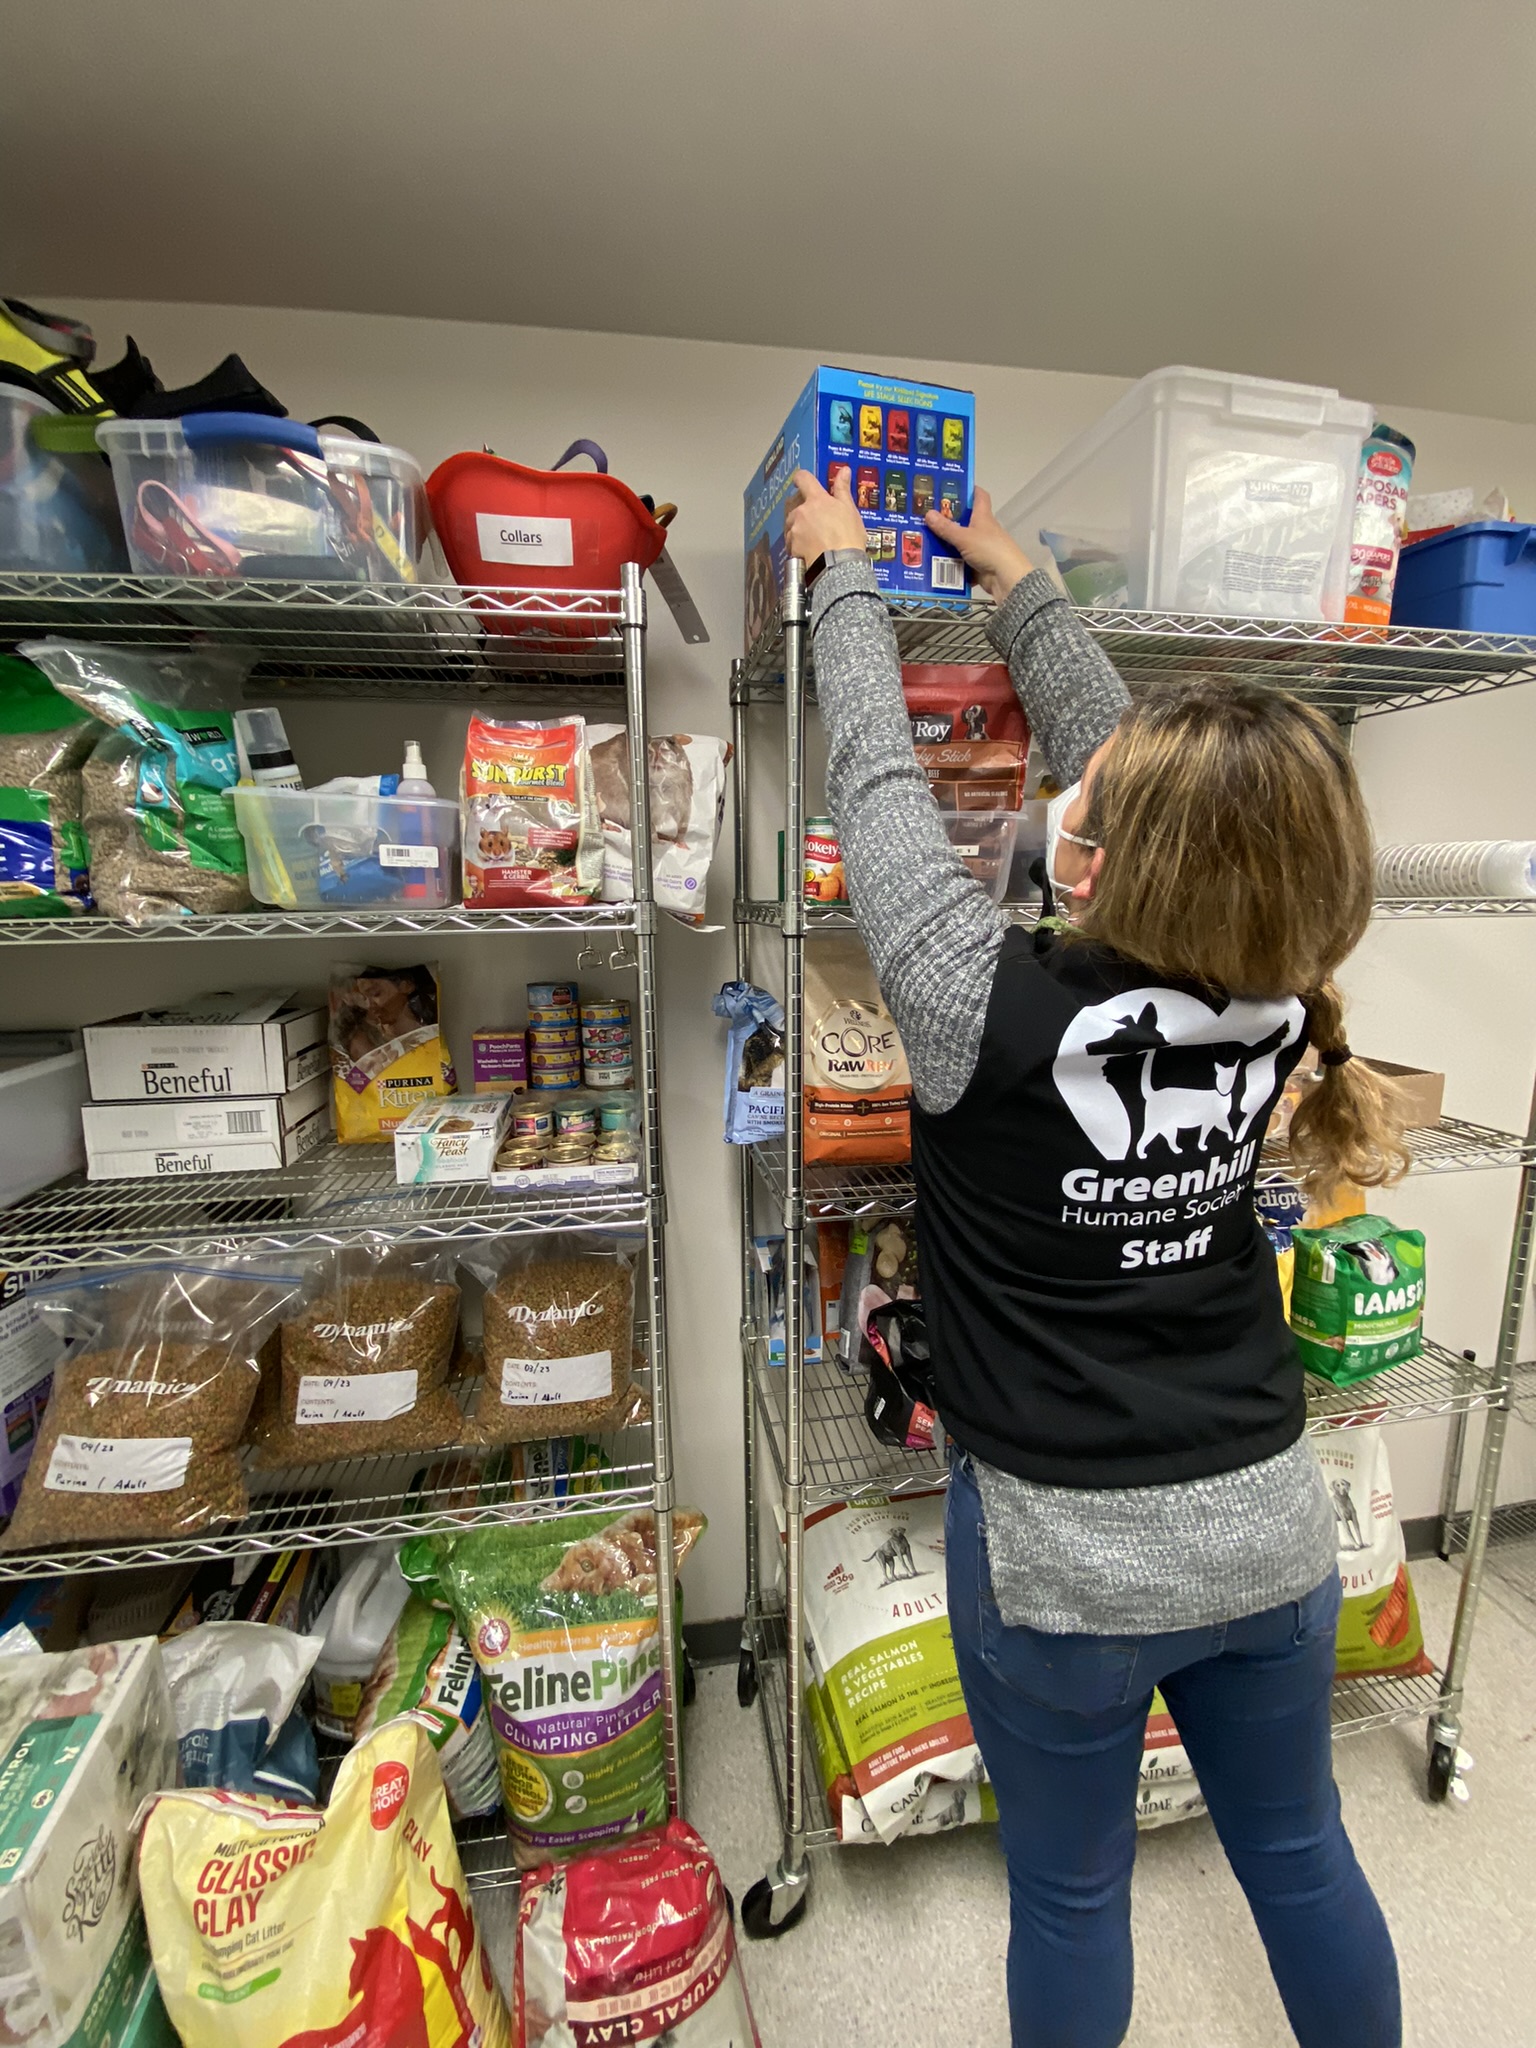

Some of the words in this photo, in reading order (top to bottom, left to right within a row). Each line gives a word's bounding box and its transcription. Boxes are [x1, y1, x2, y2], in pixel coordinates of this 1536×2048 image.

[1357, 492, 1397, 511] APERS
[500, 529, 542, 544] Collars
[937, 749, 972, 764] Stick
[928, 769, 940, 778] BEEF
[821, 1028, 896, 1058] CORE
[141, 1067, 232, 1095] Beneful
[388, 1078, 432, 1088] PURINA
[379, 1088, 436, 1108] Kitten
[748, 1104, 784, 1114] PACIFI
[430, 1137, 468, 1154] Fancy
[440, 1147, 468, 1157] Feast
[155, 1154, 212, 1173] Beneful
[1061, 1143, 1255, 1202] Greenhill
[1061, 1205, 1176, 1227] Humane
[1120, 1226, 1213, 1269] Staff
[1354, 1284, 1417, 1316] IAMS
[524, 1362, 550, 1374] 03/23
[114, 1480, 147, 1490] Adult
[836, 1573, 854, 1586] 36g
[1342, 1568, 1374, 1589] DULT
[892, 1593, 943, 1618] ADULT
[841, 1662, 868, 1684] REAL
[869, 1640, 918, 1666] SALMON
[853, 1651, 924, 1687] VEGETABLES
[848, 1678, 888, 1708] RECIPE
[907, 1690, 918, 1698] THE
[930, 1676, 959, 1690] INGREDIE
[504, 1722, 598, 1750] CLUMPING
[607, 1690, 662, 1738] LITTER
[537, 1718, 588, 1735] Natural
[0, 1738, 36, 1792] NTROL
[1140, 1765, 1179, 1780] NIDAE
[1136, 1798, 1172, 1816] NIDAE
[402, 1817, 433, 1862] CLAY
[548, 1834, 576, 1844] Easier
[578, 1825, 620, 1840] Scooping
[196, 1838, 317, 1895] CLASSIC
[640, 1874, 659, 1889] FREE
[193, 1889, 265, 1938] CLAY
[246, 1932, 260, 1946] Cat
[262, 1921, 286, 1941] Litter
[632, 1964, 662, 1984] Litter
[653, 1948, 730, 2026] NATURAL
[586, 2020, 644, 2046] CLAY
